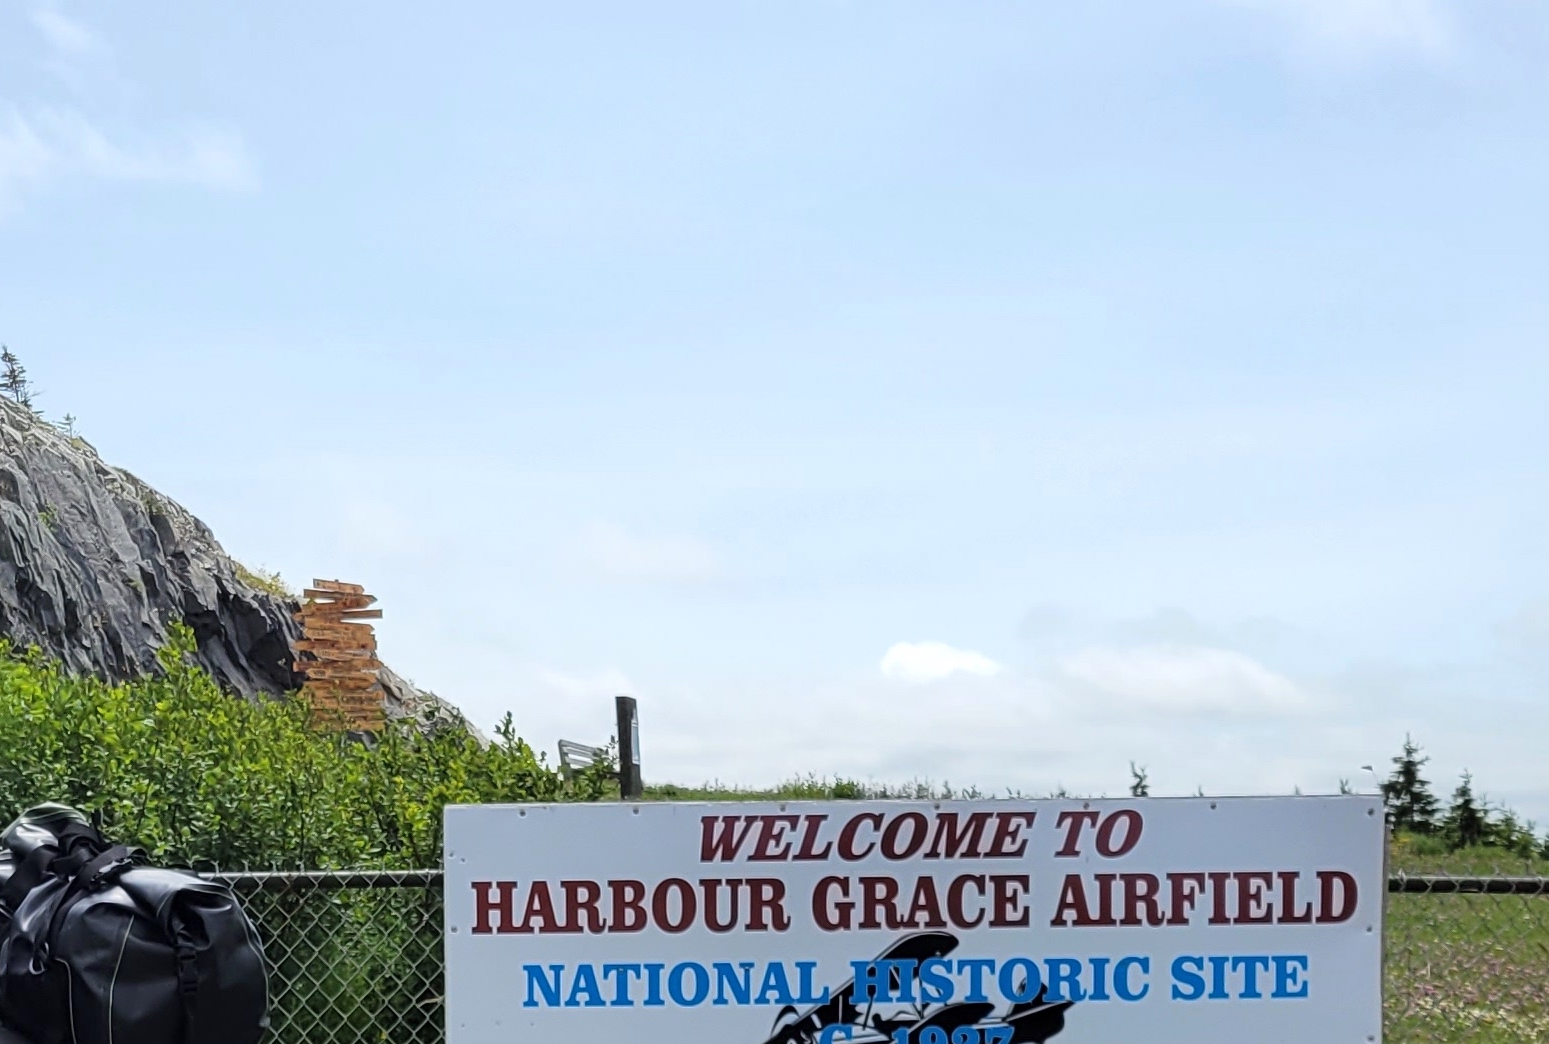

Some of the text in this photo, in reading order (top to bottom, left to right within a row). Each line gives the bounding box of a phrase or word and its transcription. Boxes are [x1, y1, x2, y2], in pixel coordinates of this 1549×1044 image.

[699, 808, 1144, 863] WELCOME TO
[470, 870, 1359, 935] HARBOUR GRACE AIRFIELD
[522, 955, 1309, 1008] NATIONAL HISTORIC SITE
